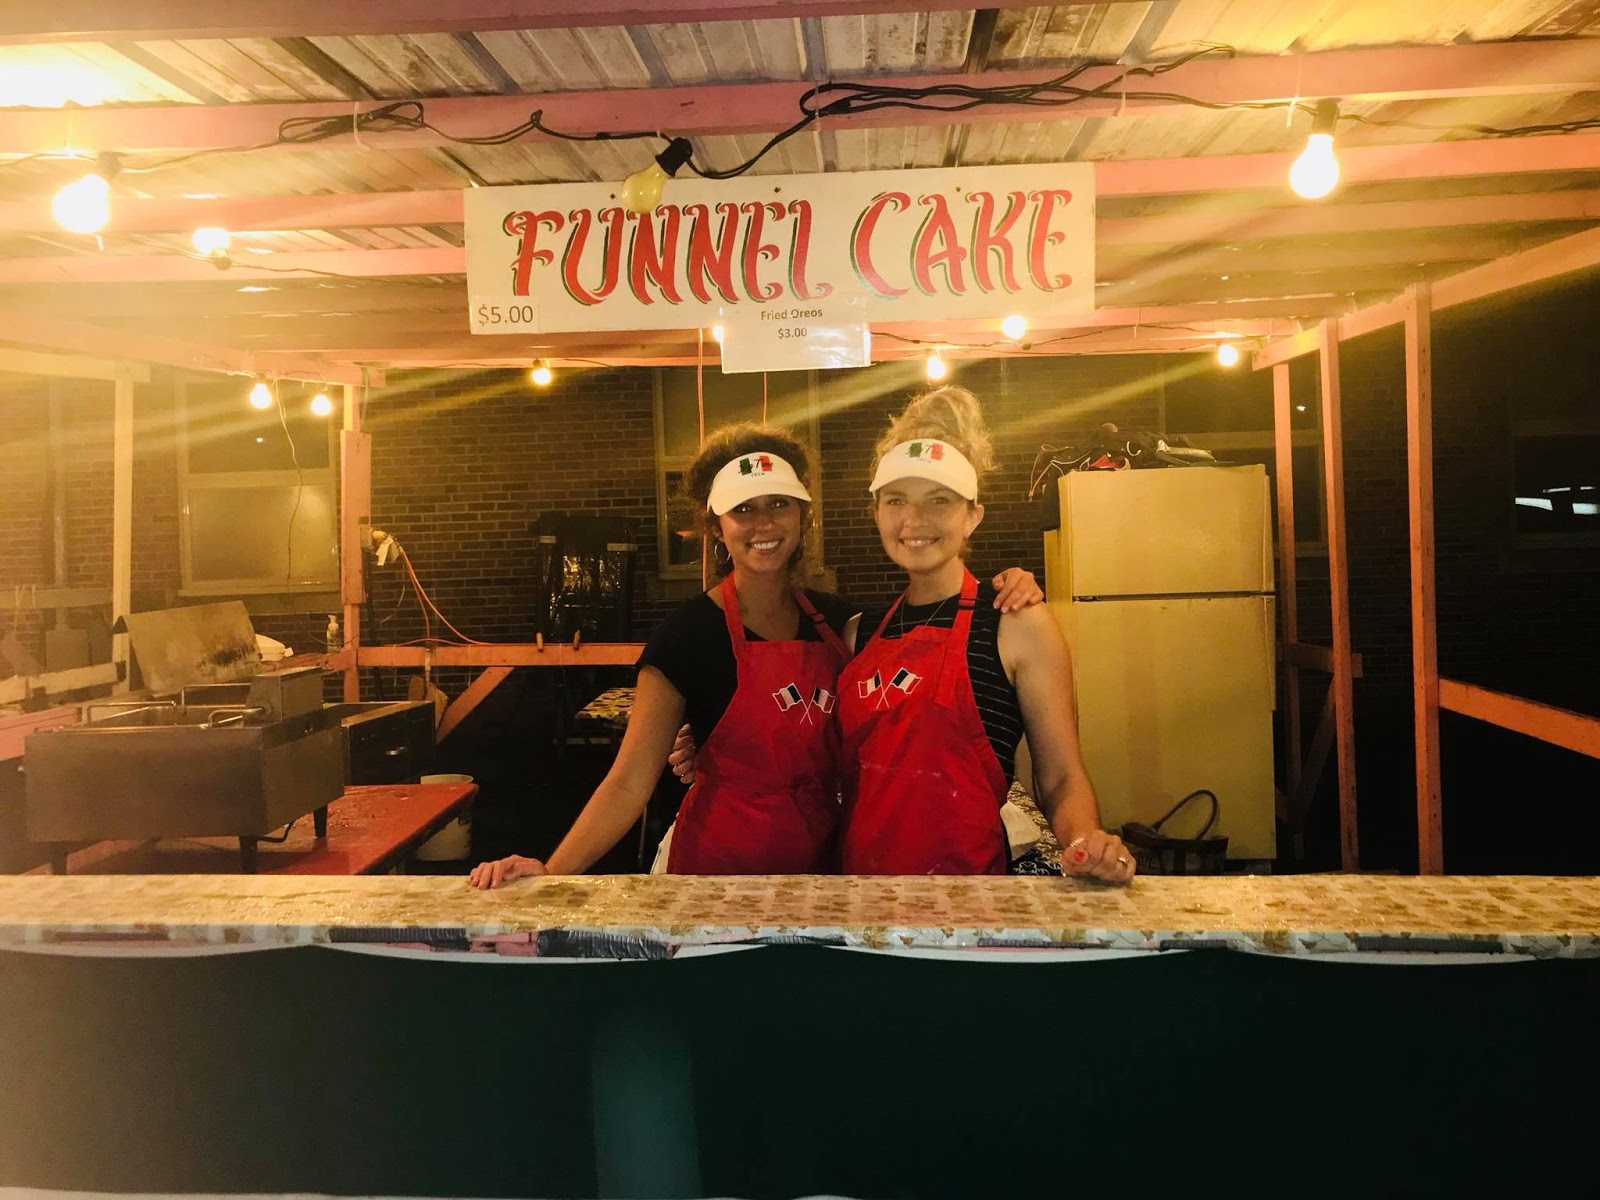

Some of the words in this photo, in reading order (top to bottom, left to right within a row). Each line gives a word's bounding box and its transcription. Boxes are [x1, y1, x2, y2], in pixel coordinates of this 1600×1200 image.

[502, 199, 834, 306] FUNNEL
[849, 189, 1073, 300] CAKE
[478, 303, 534, 327] $5.00
[760, 309, 788, 321] Fried
[791, 308, 823, 319] Oreos
[777, 327, 808, 340] $3.00
